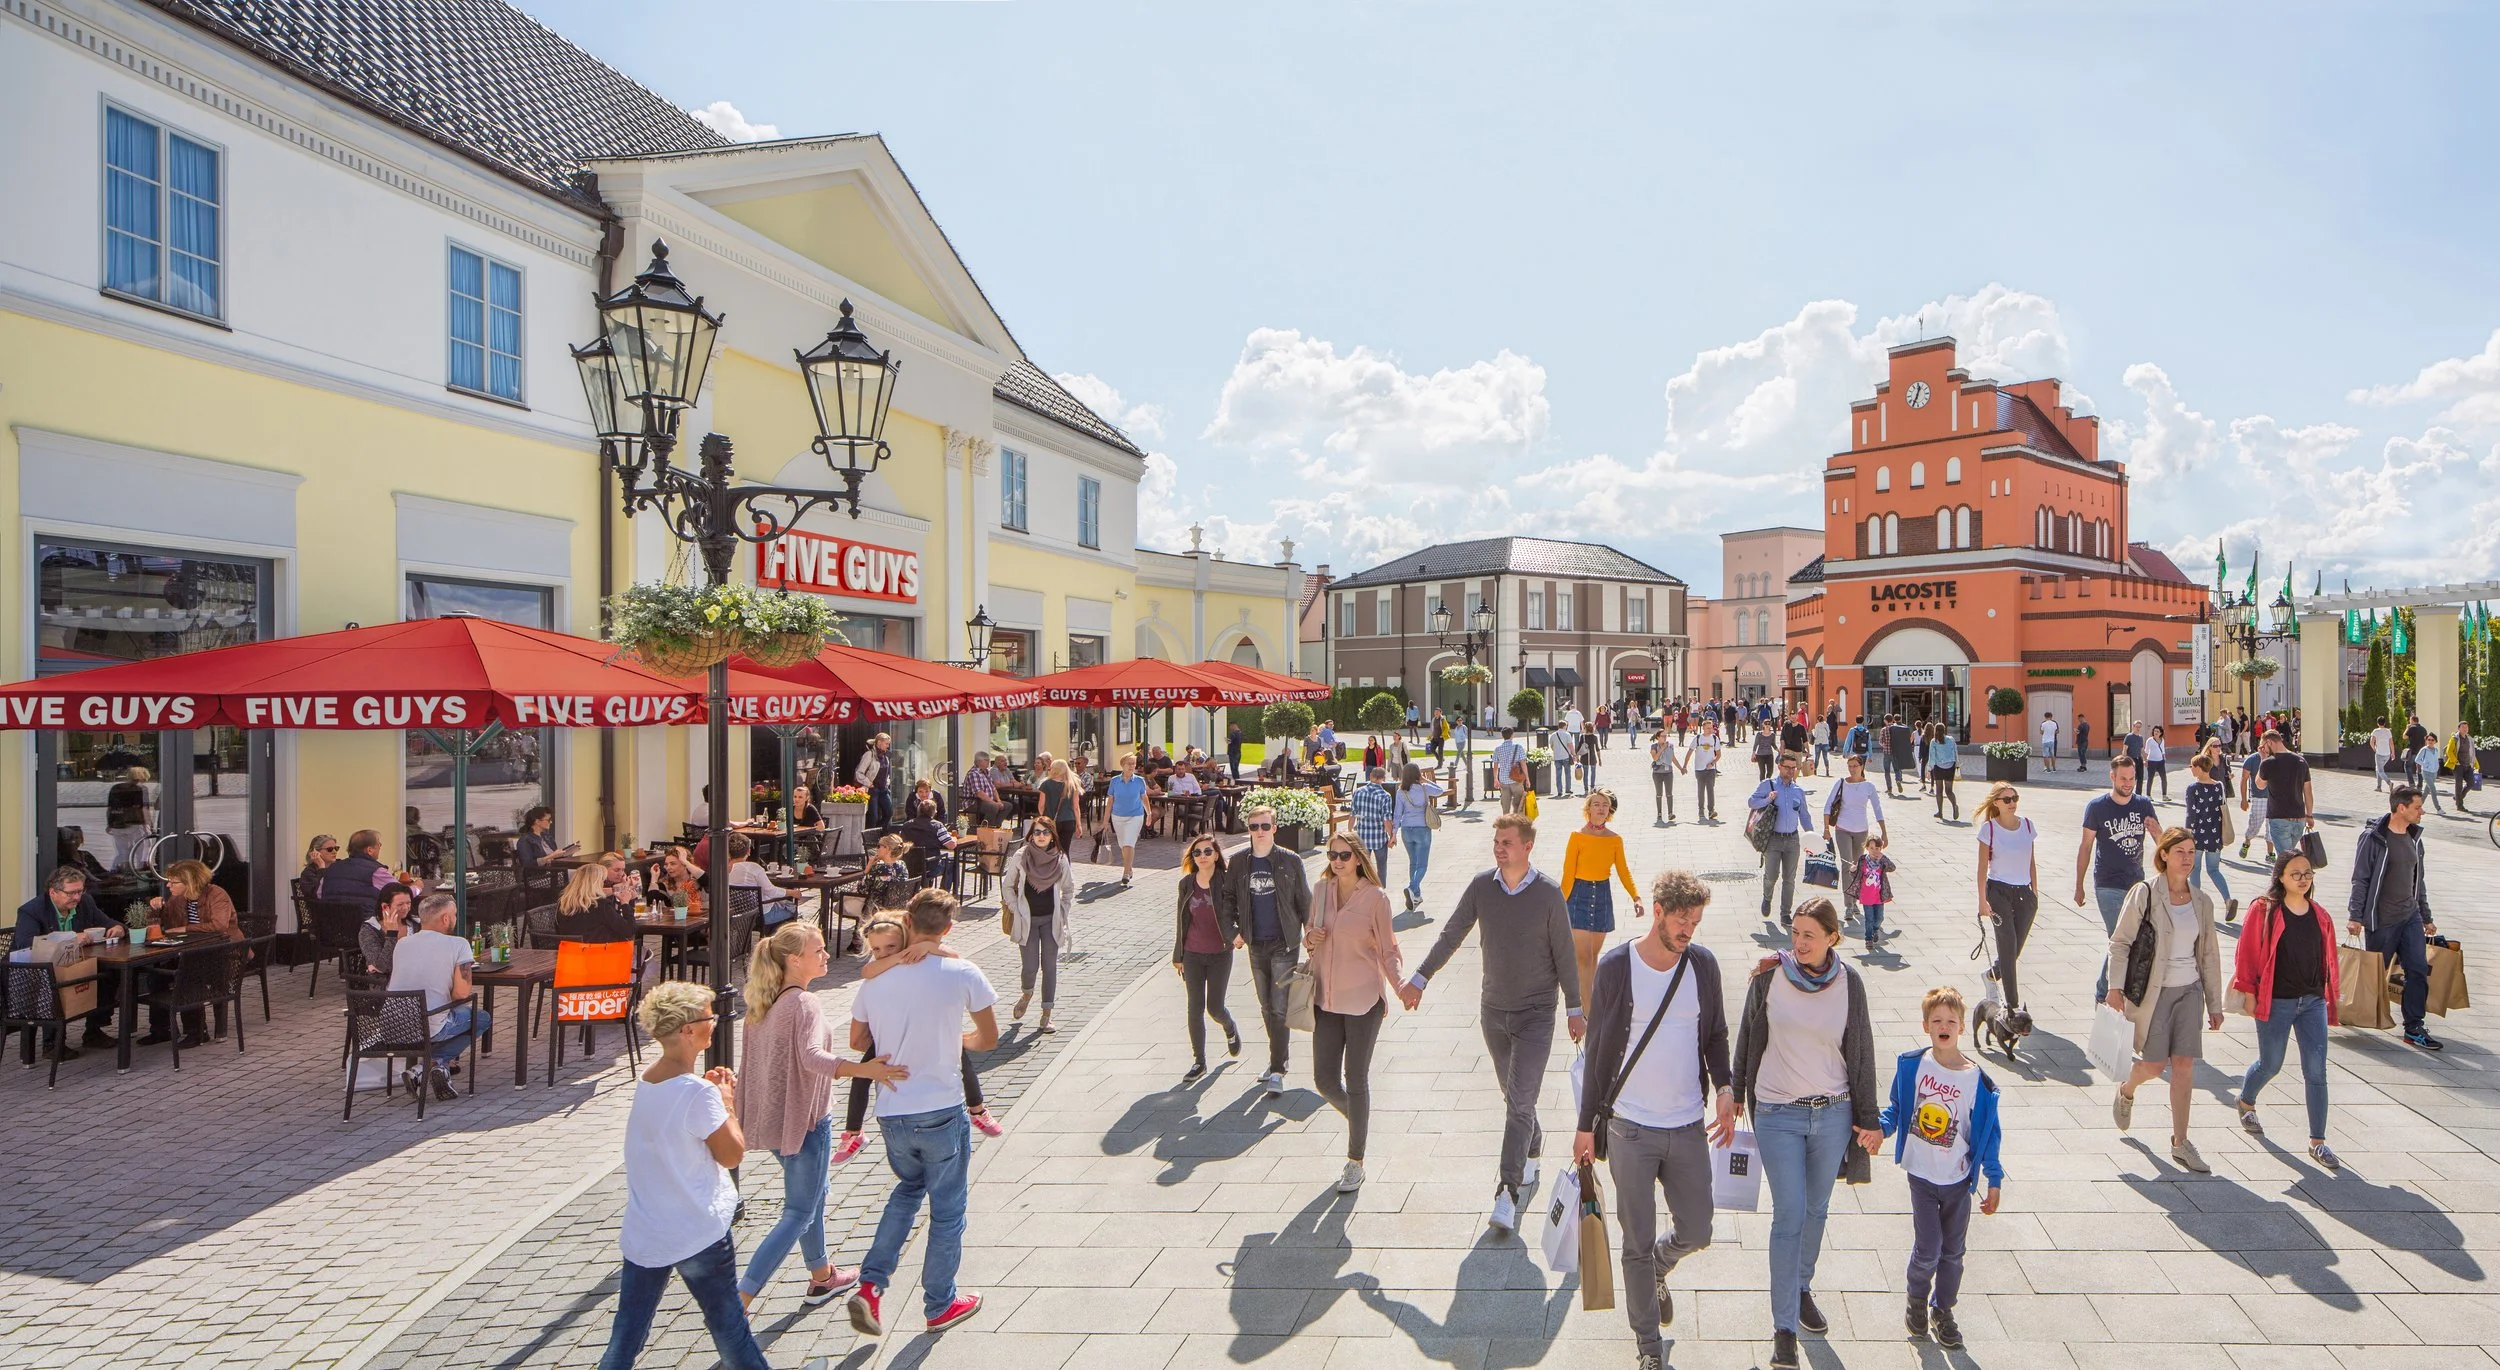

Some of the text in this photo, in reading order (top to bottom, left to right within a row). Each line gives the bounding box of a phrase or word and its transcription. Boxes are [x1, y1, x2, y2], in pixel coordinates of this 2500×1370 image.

[764, 532, 919, 597] FIVE GUYS
[1871, 581, 1957, 601] LACOSTE
[1871, 600, 1957, 612] OUTLET
[1897, 669, 1934, 677] LACOSTE
[973, 695, 1005, 710] FIVE
[1007, 691, 1040, 710] GUYS
[1050, 689, 1087, 701] GUYS
[1112, 688, 1199, 700] FIVE GUYS
[1220, 690, 1288, 703] FIVE GUYS
[1290, 689, 1329, 700] IVE GUYS
[2174, 697, 2202, 708] SALAMANDE
[0, 696, 195, 725] IVE GUYS
[245, 695, 467, 725] FIVE GUYS
[514, 695, 688, 723] FIVE GUYS
[728, 697, 759, 718] VE
[765, 694, 827, 718] GUYS
[873, 698, 959, 717] FIVE GUYS
[2129, 811, 2141, 823] 85
[558, 995, 627, 1020] Super
[1920, 1073, 1961, 1099] Music
